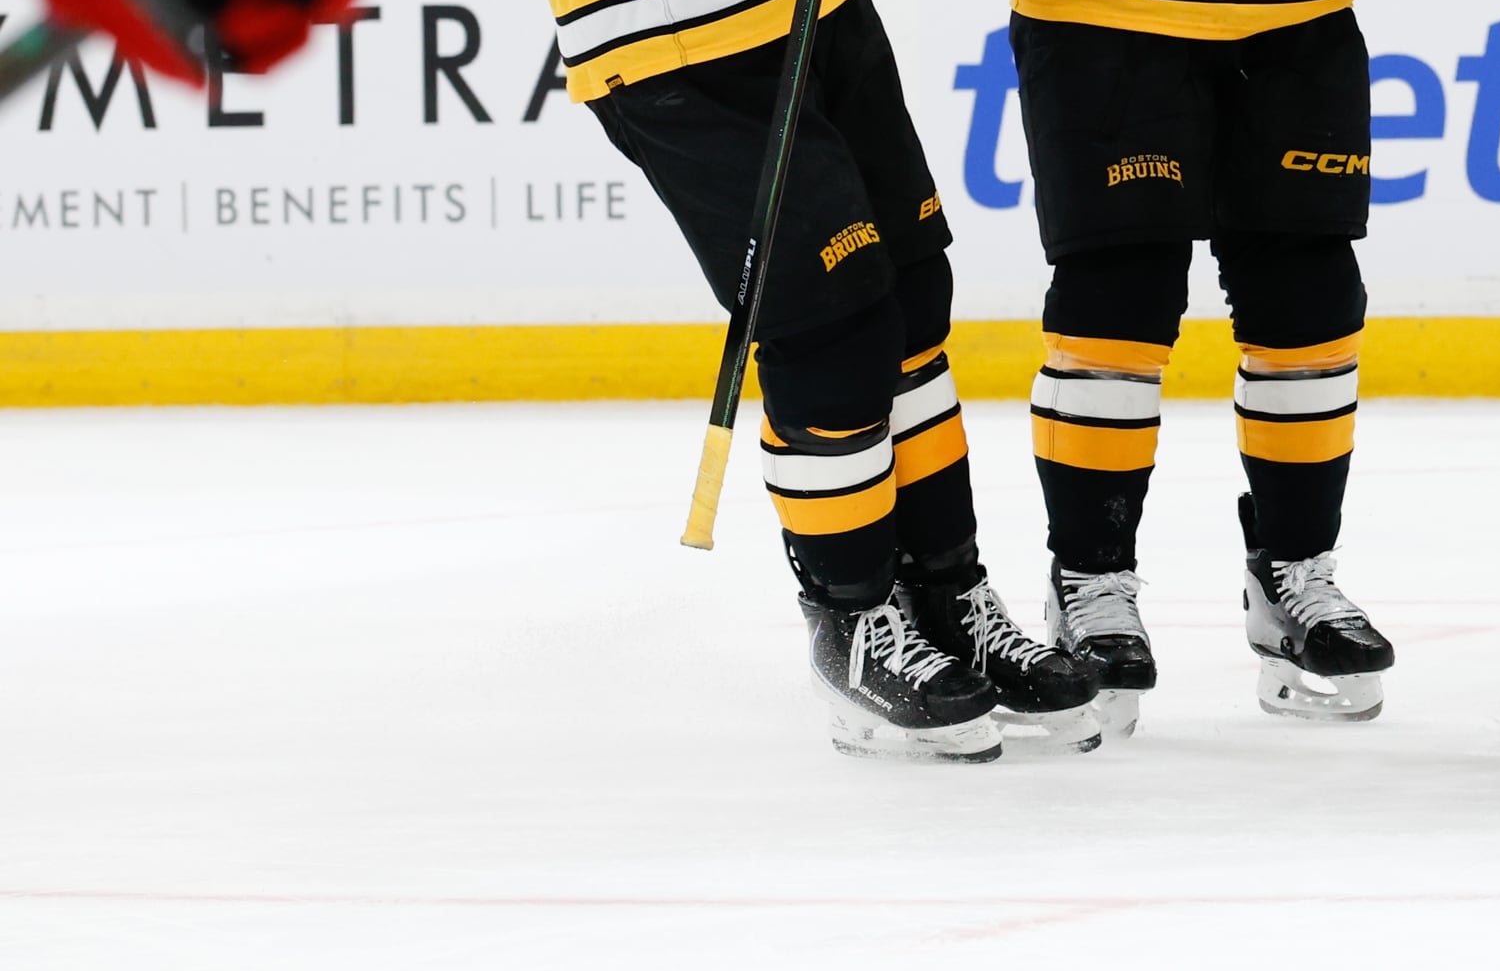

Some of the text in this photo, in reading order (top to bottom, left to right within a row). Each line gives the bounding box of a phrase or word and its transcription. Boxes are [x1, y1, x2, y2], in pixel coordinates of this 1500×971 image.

[1106, 159, 1182, 187] BRUINS
[1120, 154, 1168, 165] BOSTON
[1281, 150, 1370, 176] CCM
[215, 184, 467, 225] BENEFITS
[525, 182, 627, 221] LIFE
[819, 222, 880, 272] BRUINS
[830, 221, 865, 245] BOSTON
[857, 684, 893, 713] AUER
